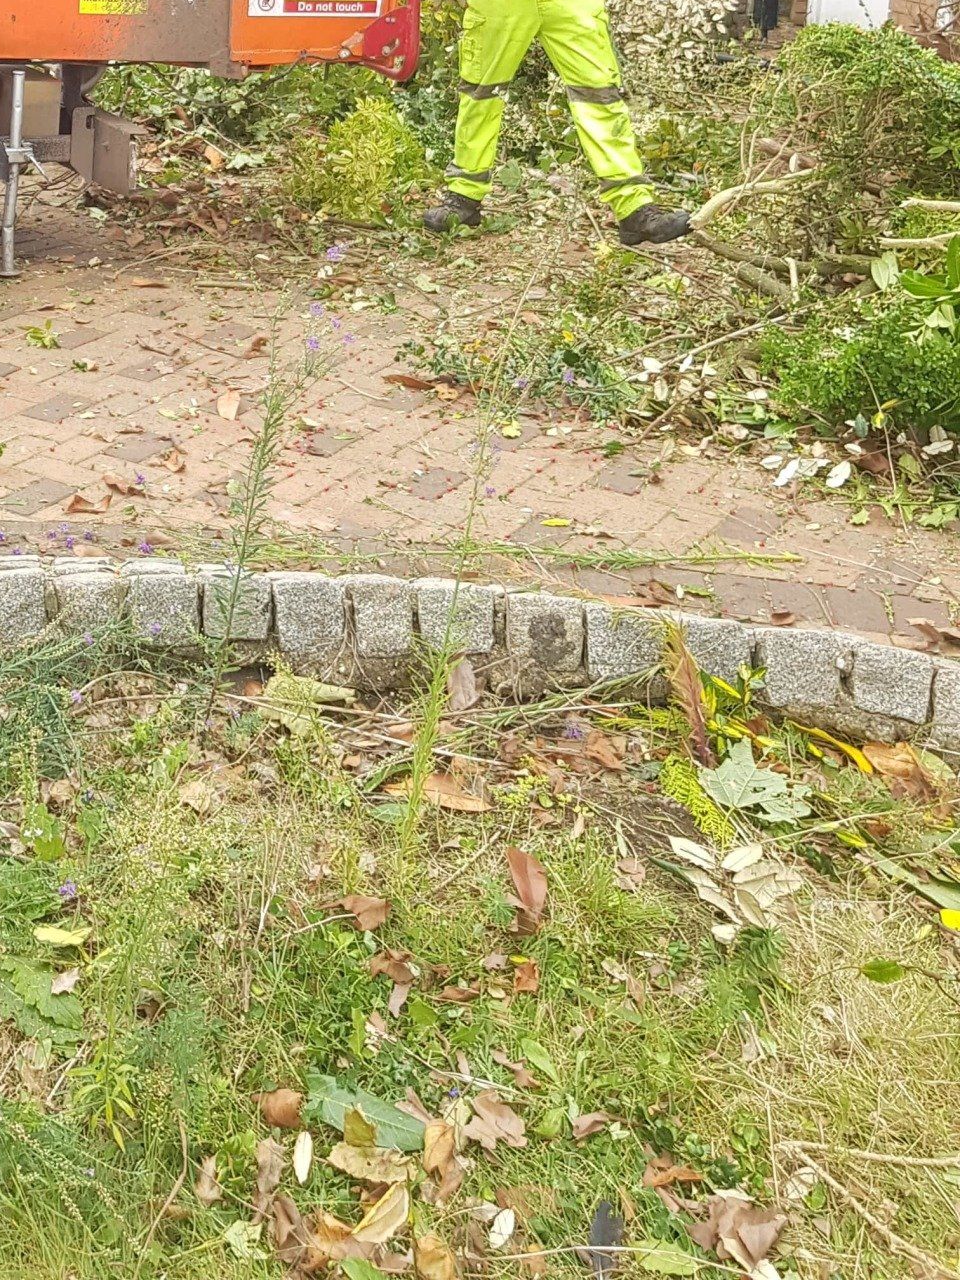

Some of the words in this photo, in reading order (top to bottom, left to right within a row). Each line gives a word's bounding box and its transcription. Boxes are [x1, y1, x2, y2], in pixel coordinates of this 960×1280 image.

[297, 3, 313, 12] Do
[316, 3, 332, 12] not
[335, 3, 363, 12] touch
